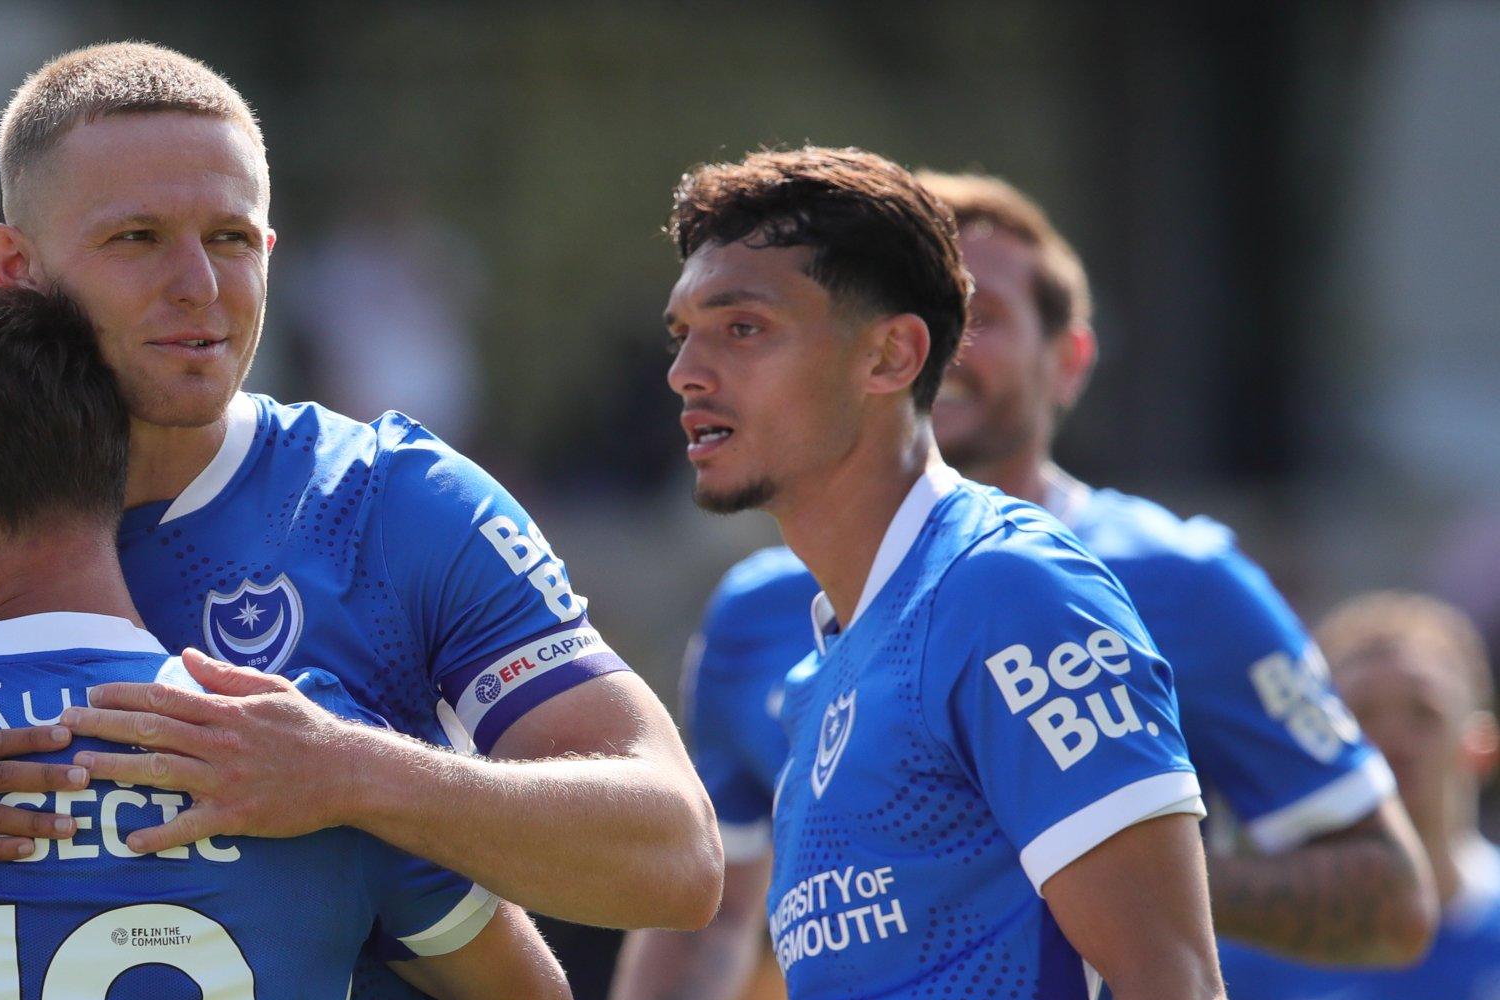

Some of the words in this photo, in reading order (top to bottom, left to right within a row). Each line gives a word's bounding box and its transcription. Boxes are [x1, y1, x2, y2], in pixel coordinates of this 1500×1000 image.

[499, 656, 536, 684] EFL
[984, 628, 1131, 715] Bee
[1026, 684, 1160, 772] Bu.
[855, 866, 895, 899] OF
[131, 928, 148, 937] EFL
[150, 927, 161, 937] IN
[163, 926, 180, 936] THE
[131, 935, 192, 947] COMMUNITY
